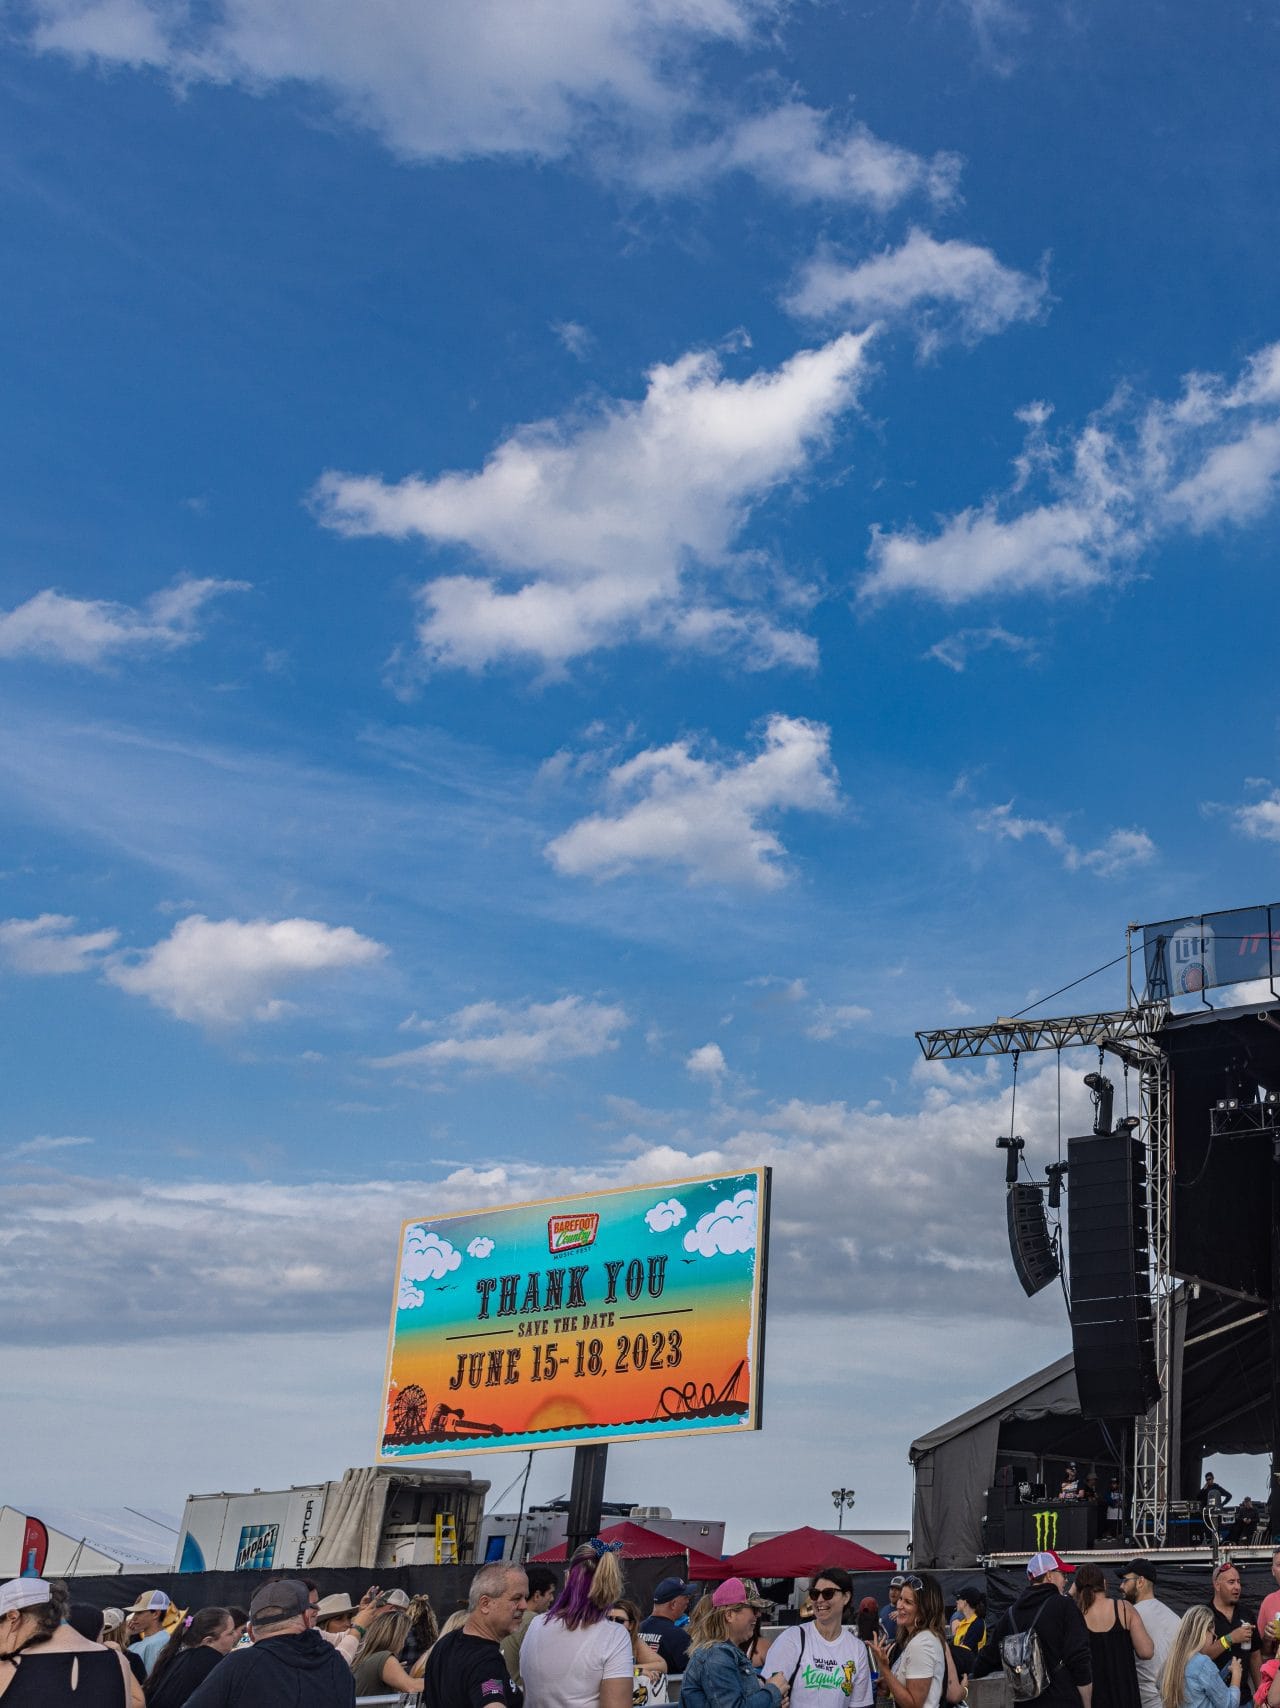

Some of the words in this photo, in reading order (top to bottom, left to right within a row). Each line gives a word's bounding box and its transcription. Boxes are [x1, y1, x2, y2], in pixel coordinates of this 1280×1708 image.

[554, 1216, 596, 1234] BAREFOOT
[555, 1229, 592, 1248] Country
[553, 1251, 575, 1260] MUSIC
[575, 1246, 592, 1255] FEST
[476, 1264, 590, 1320] THANK
[604, 1254, 668, 1304] YOU
[518, 1319, 549, 1338] SAVE
[553, 1315, 578, 1334] THE
[581, 1311, 616, 1331] DATE
[449, 1347, 522, 1391] JUNE
[531, 1338, 607, 1382] 15-18,
[615, 1329, 684, 1374] 2023
[237, 1527, 277, 1567] IMPACT
[802, 1664, 844, 1689] tequila
